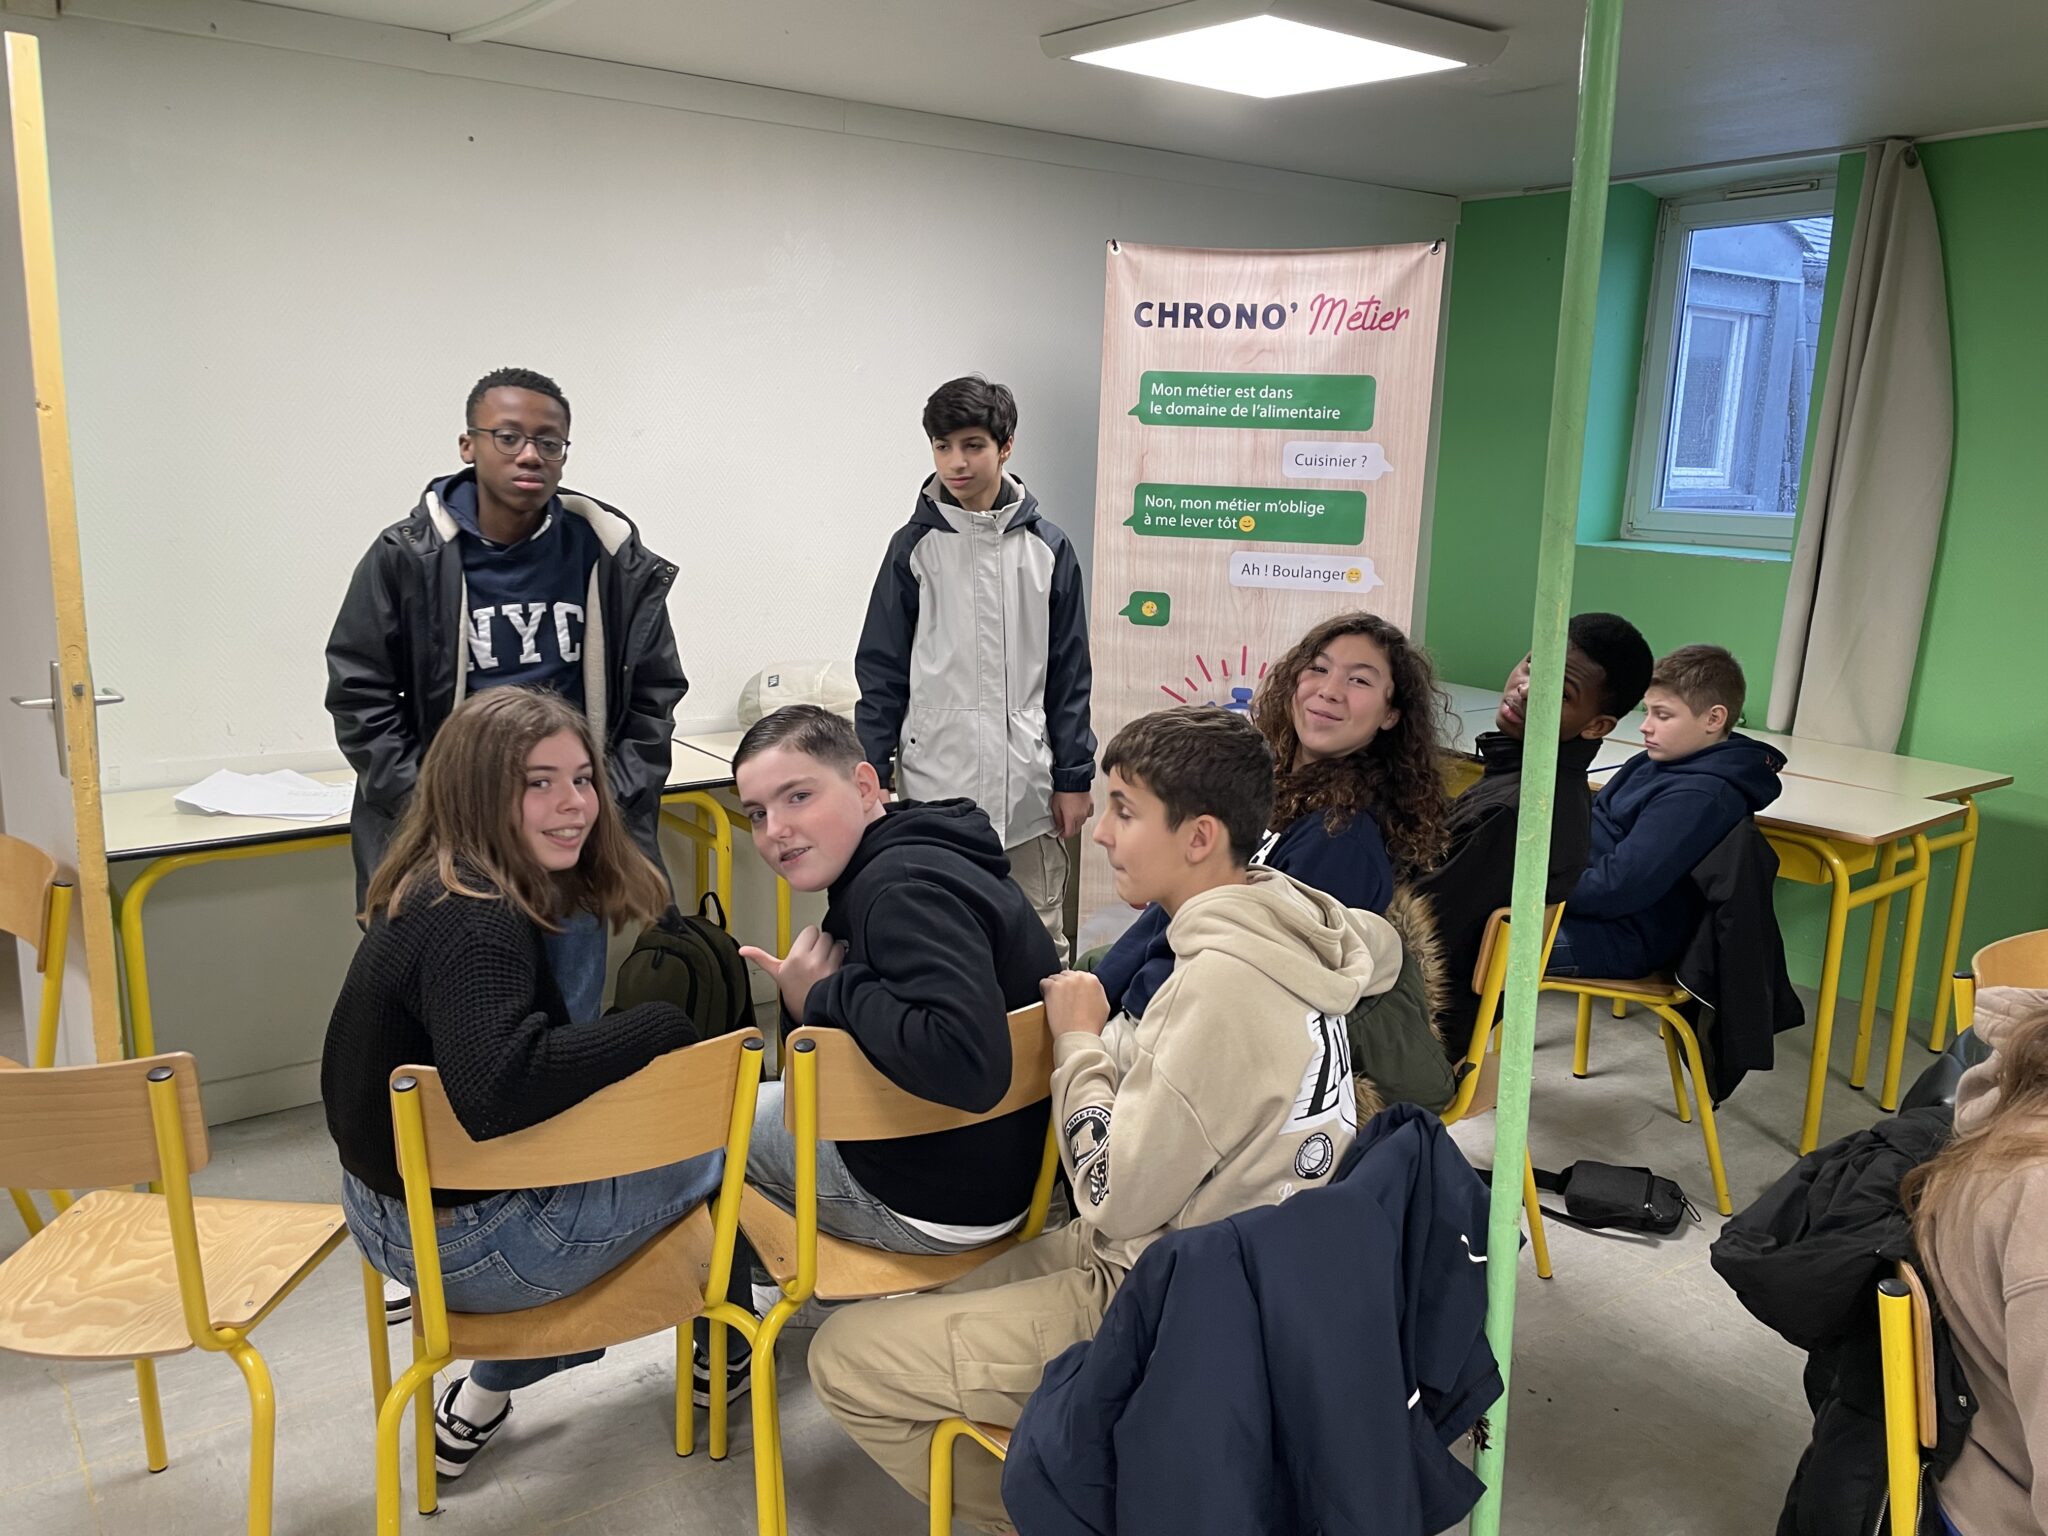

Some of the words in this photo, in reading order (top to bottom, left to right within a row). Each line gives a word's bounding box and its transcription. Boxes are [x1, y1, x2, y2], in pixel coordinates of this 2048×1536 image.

[1151, 382, 1182, 396] Mon
[1186, 384, 1232, 397] métier
[1234, 386, 1256, 398] est
[1259, 384, 1293, 399] dans
[1150, 401, 1162, 414] le
[1165, 402, 1227, 416] domaine
[1230, 403, 1249, 417] de
[1294, 453, 1357, 467] Cuisinier
[1361, 455, 1368, 468] ?
[1145, 494, 1177, 510] Non,
[1180, 499, 1211, 510] mon
[1215, 498, 1261, 512] métier
[1144, 512, 1152, 525] à
[1155, 516, 1177, 527] me
[1180, 513, 1214, 528] lever
[1217, 516, 1238, 530] tôt
[1241, 563, 1260, 576] Ah
[1264, 564, 1268, 577] !
[1272, 564, 1346, 583] Boulanger
[467, 602, 585, 672] NYC
[1066, 1109, 1111, 1134] ASKETBALL
[451, 1420, 473, 1437] NIKE
